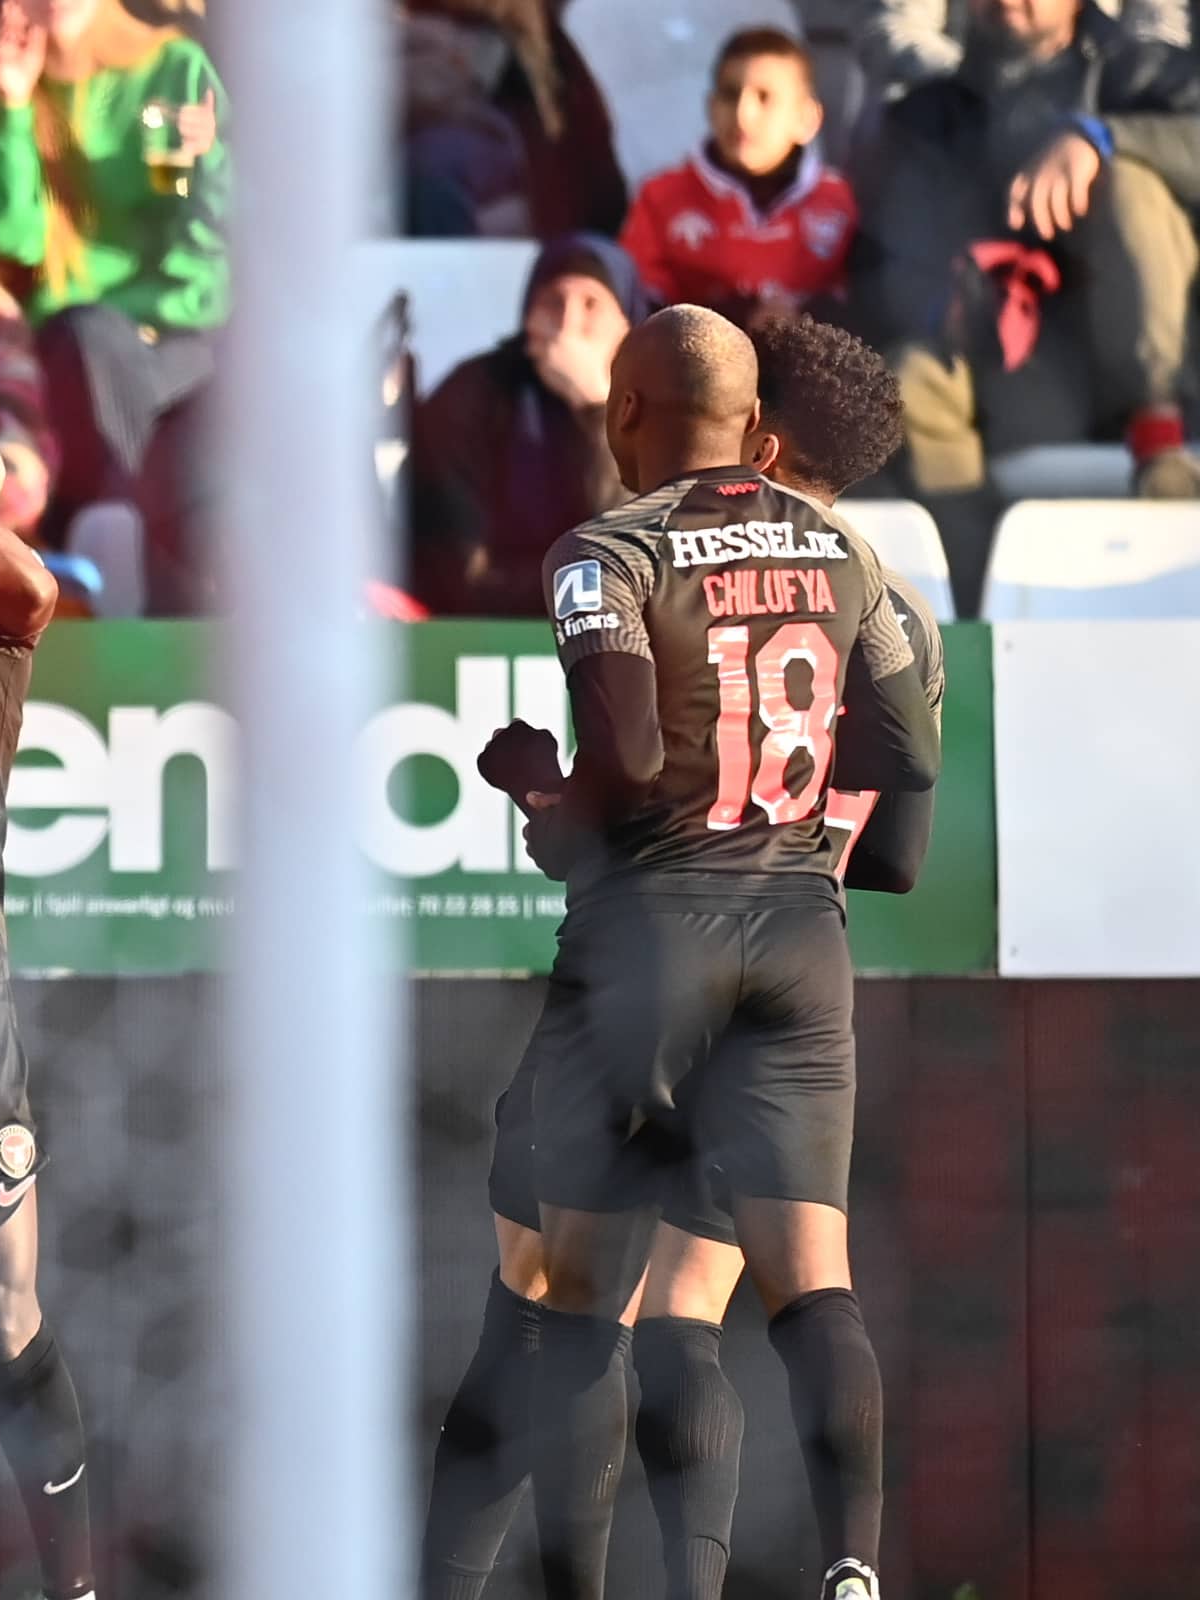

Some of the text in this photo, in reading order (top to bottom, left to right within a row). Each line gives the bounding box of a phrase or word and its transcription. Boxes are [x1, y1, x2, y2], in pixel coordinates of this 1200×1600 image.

[702, 568, 837, 617] CHILUFYA
[564, 612, 620, 637] finans
[707, 622, 839, 831] 18
